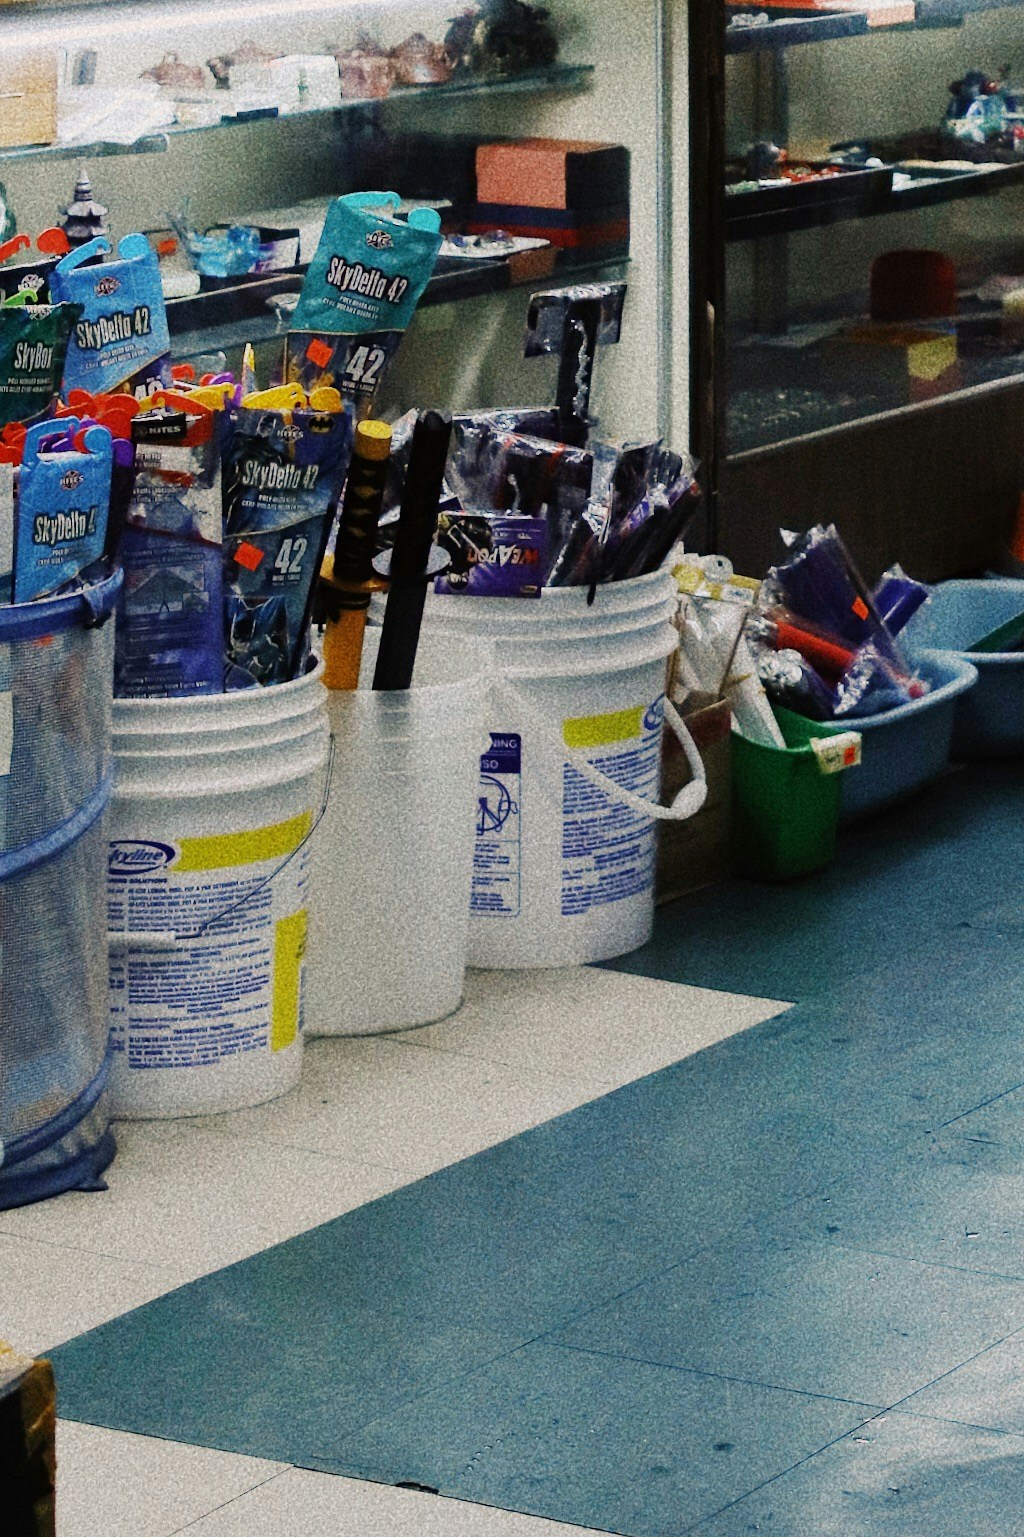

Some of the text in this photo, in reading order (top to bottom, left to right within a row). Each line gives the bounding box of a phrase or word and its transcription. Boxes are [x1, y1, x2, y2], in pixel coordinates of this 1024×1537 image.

[327, 257, 408, 303] SkyDelta 42
[76, 308, 150, 349] SkyDelta 42
[346, 345, 386, 384] 42
[149, 425, 181, 434] KITES
[242, 461, 319, 490] SkyDelta 42
[35, 510, 87, 544] SkyDelta
[274, 538, 309, 574] 42
